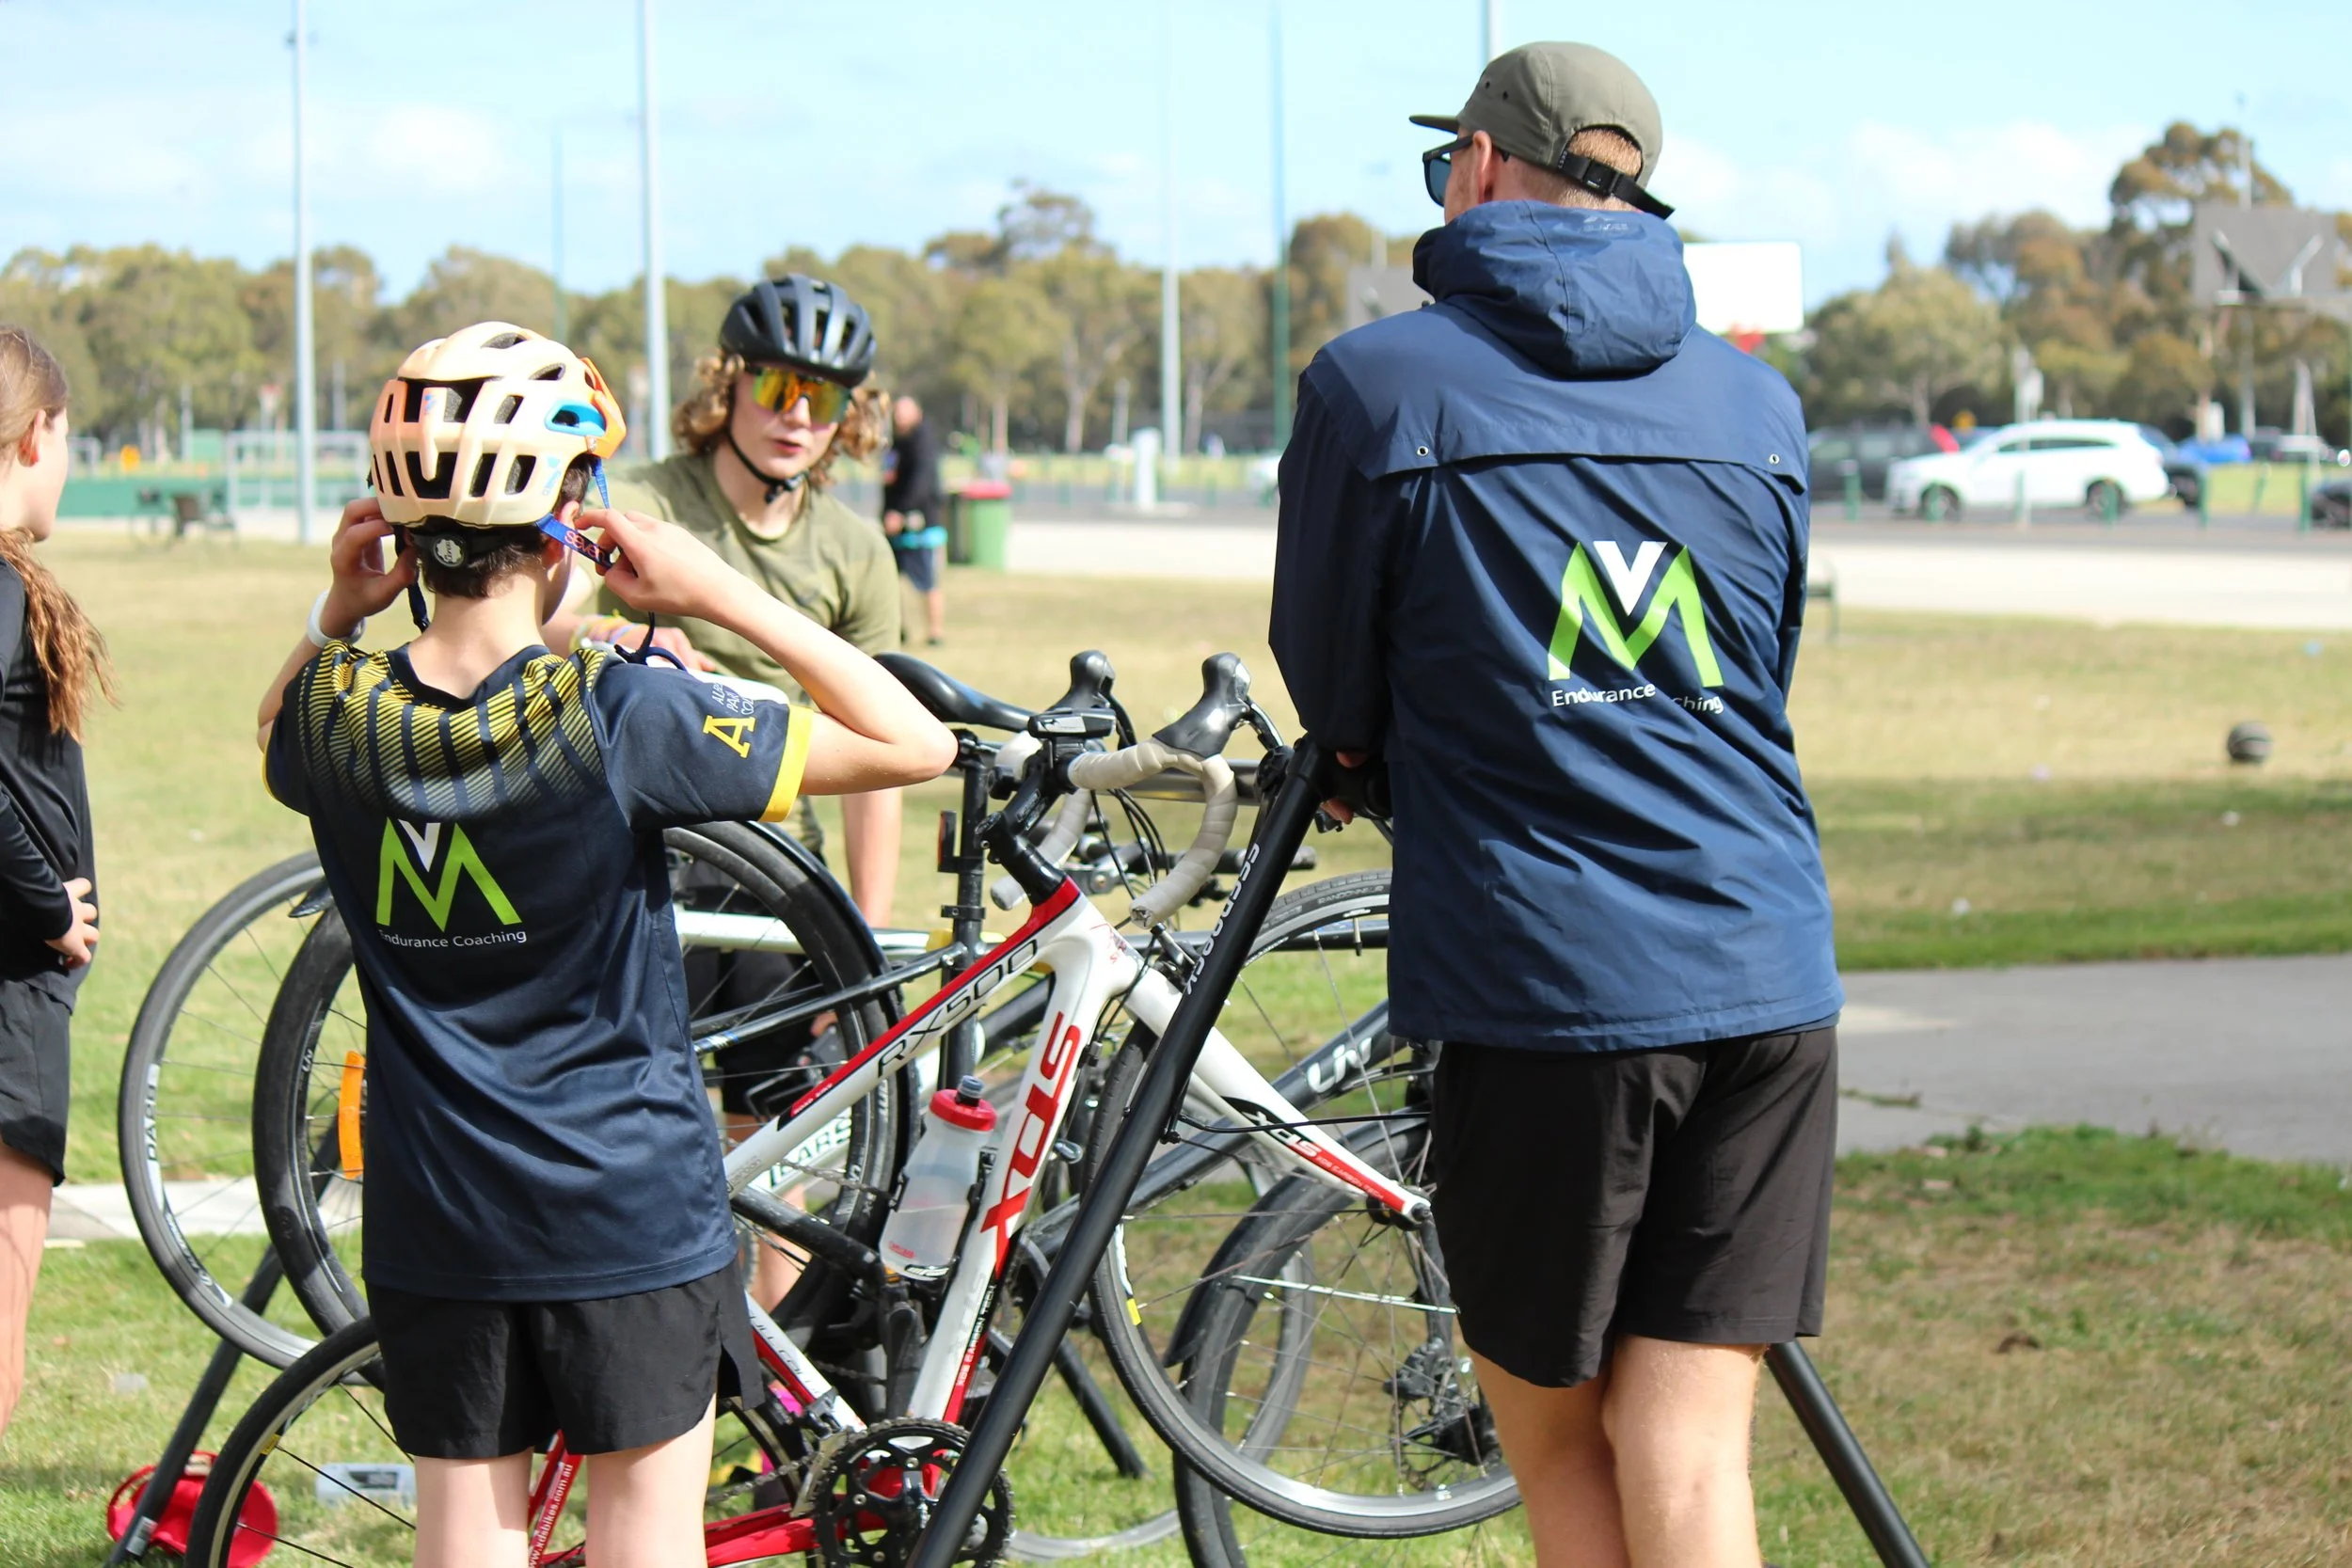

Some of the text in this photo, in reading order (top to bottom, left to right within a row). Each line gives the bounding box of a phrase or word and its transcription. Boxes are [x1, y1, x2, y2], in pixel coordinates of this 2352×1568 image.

[1551, 683, 1656, 707] Endurance
[453, 930, 528, 947] Coaching
[877, 939, 1038, 1078] RX500
